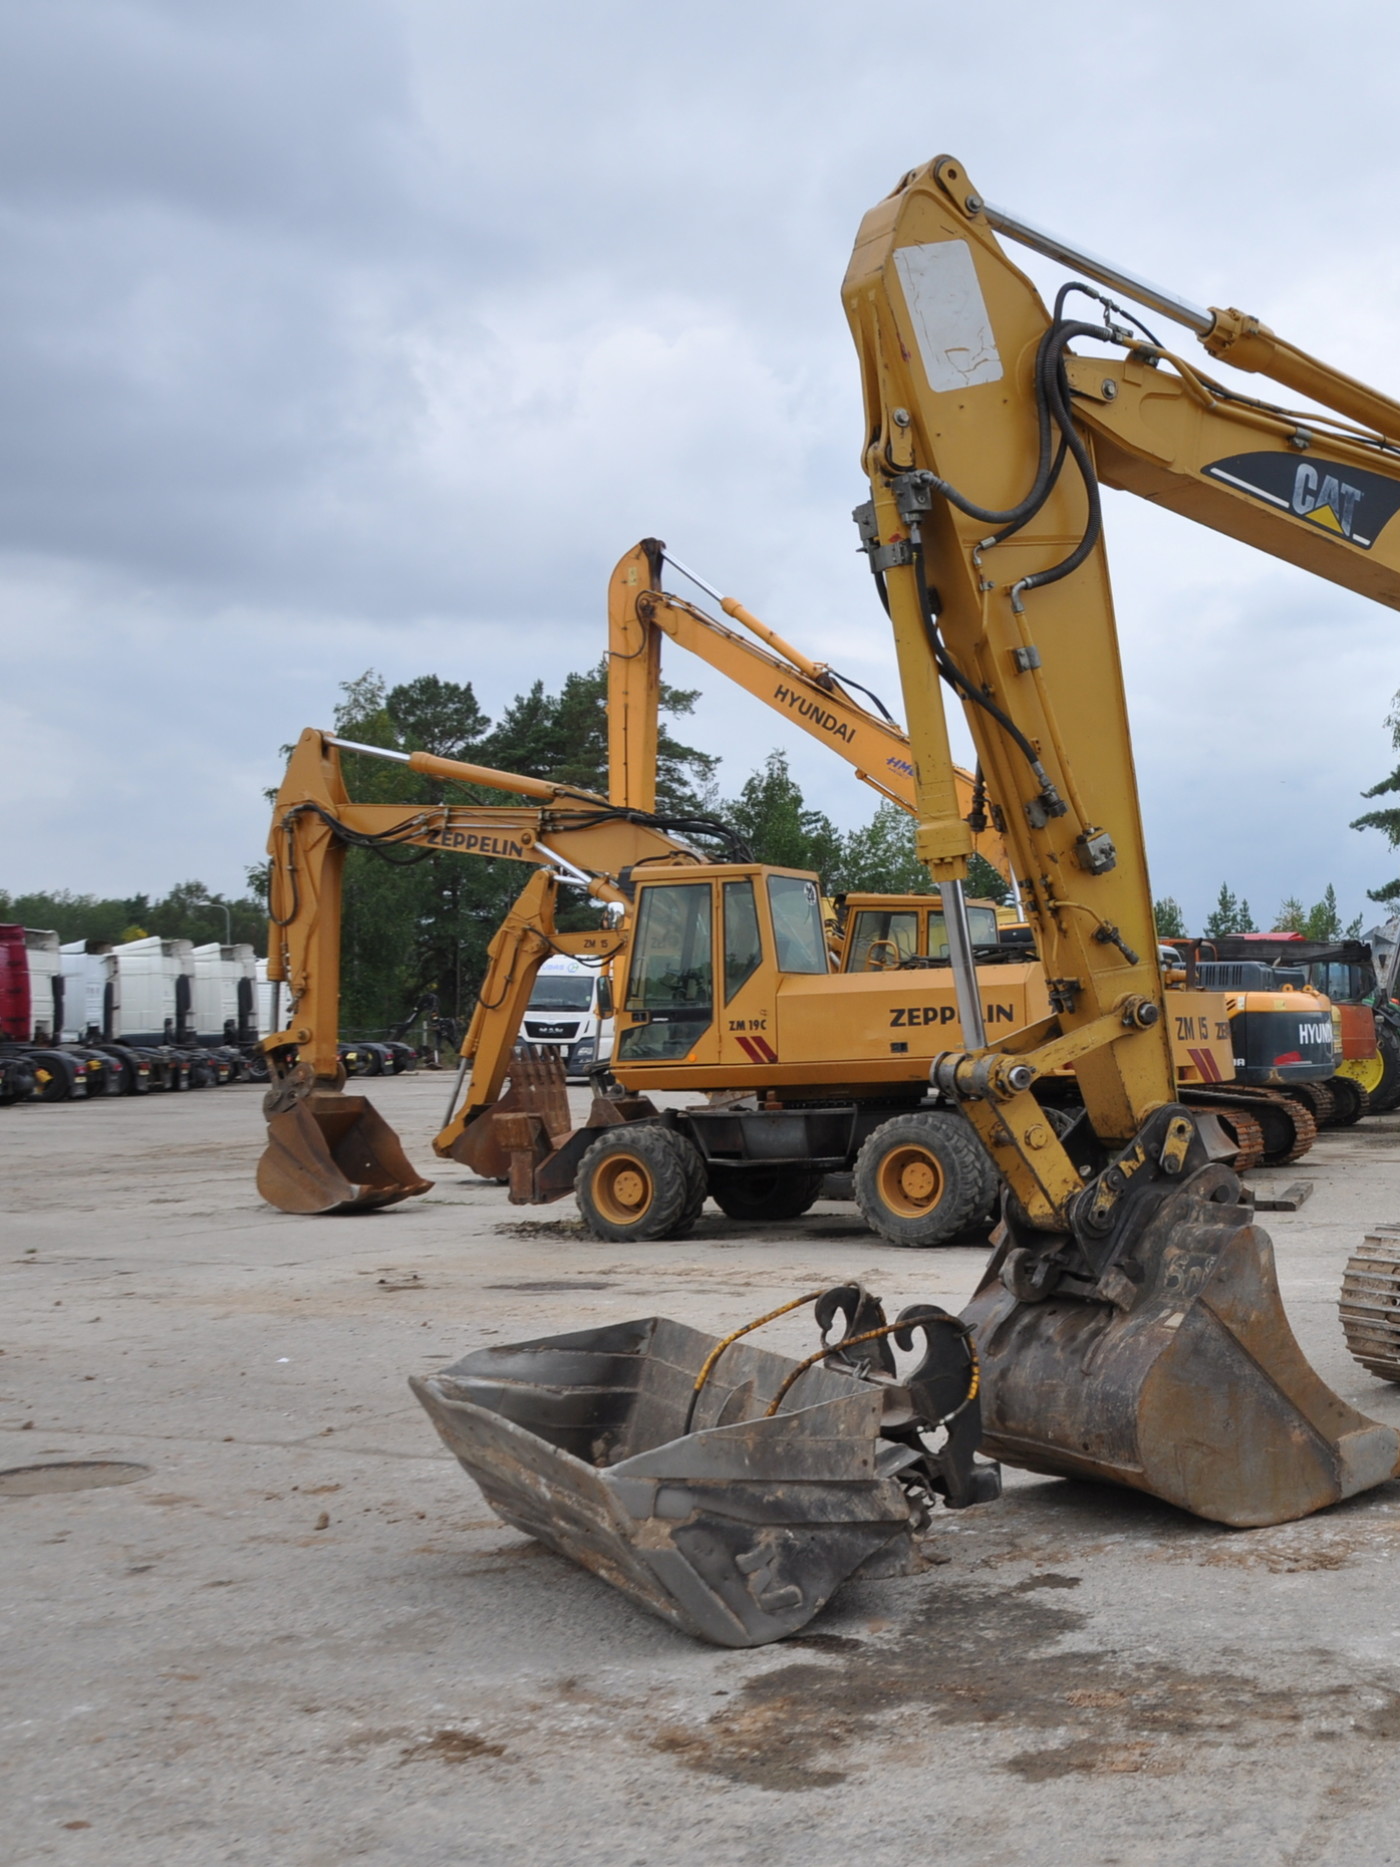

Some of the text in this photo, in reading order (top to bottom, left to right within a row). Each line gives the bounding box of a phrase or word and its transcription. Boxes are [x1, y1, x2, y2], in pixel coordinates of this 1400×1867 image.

[1292, 463, 1361, 537] CAT
[773, 684, 857, 744] HYUNDAI
[427, 829, 523, 857] ZEPPELIN
[729, 1019, 767, 1031] ZM 19C
[889, 1003, 1014, 1027] ZEPPIN
[1175, 1017, 1209, 1041] ZM 15
